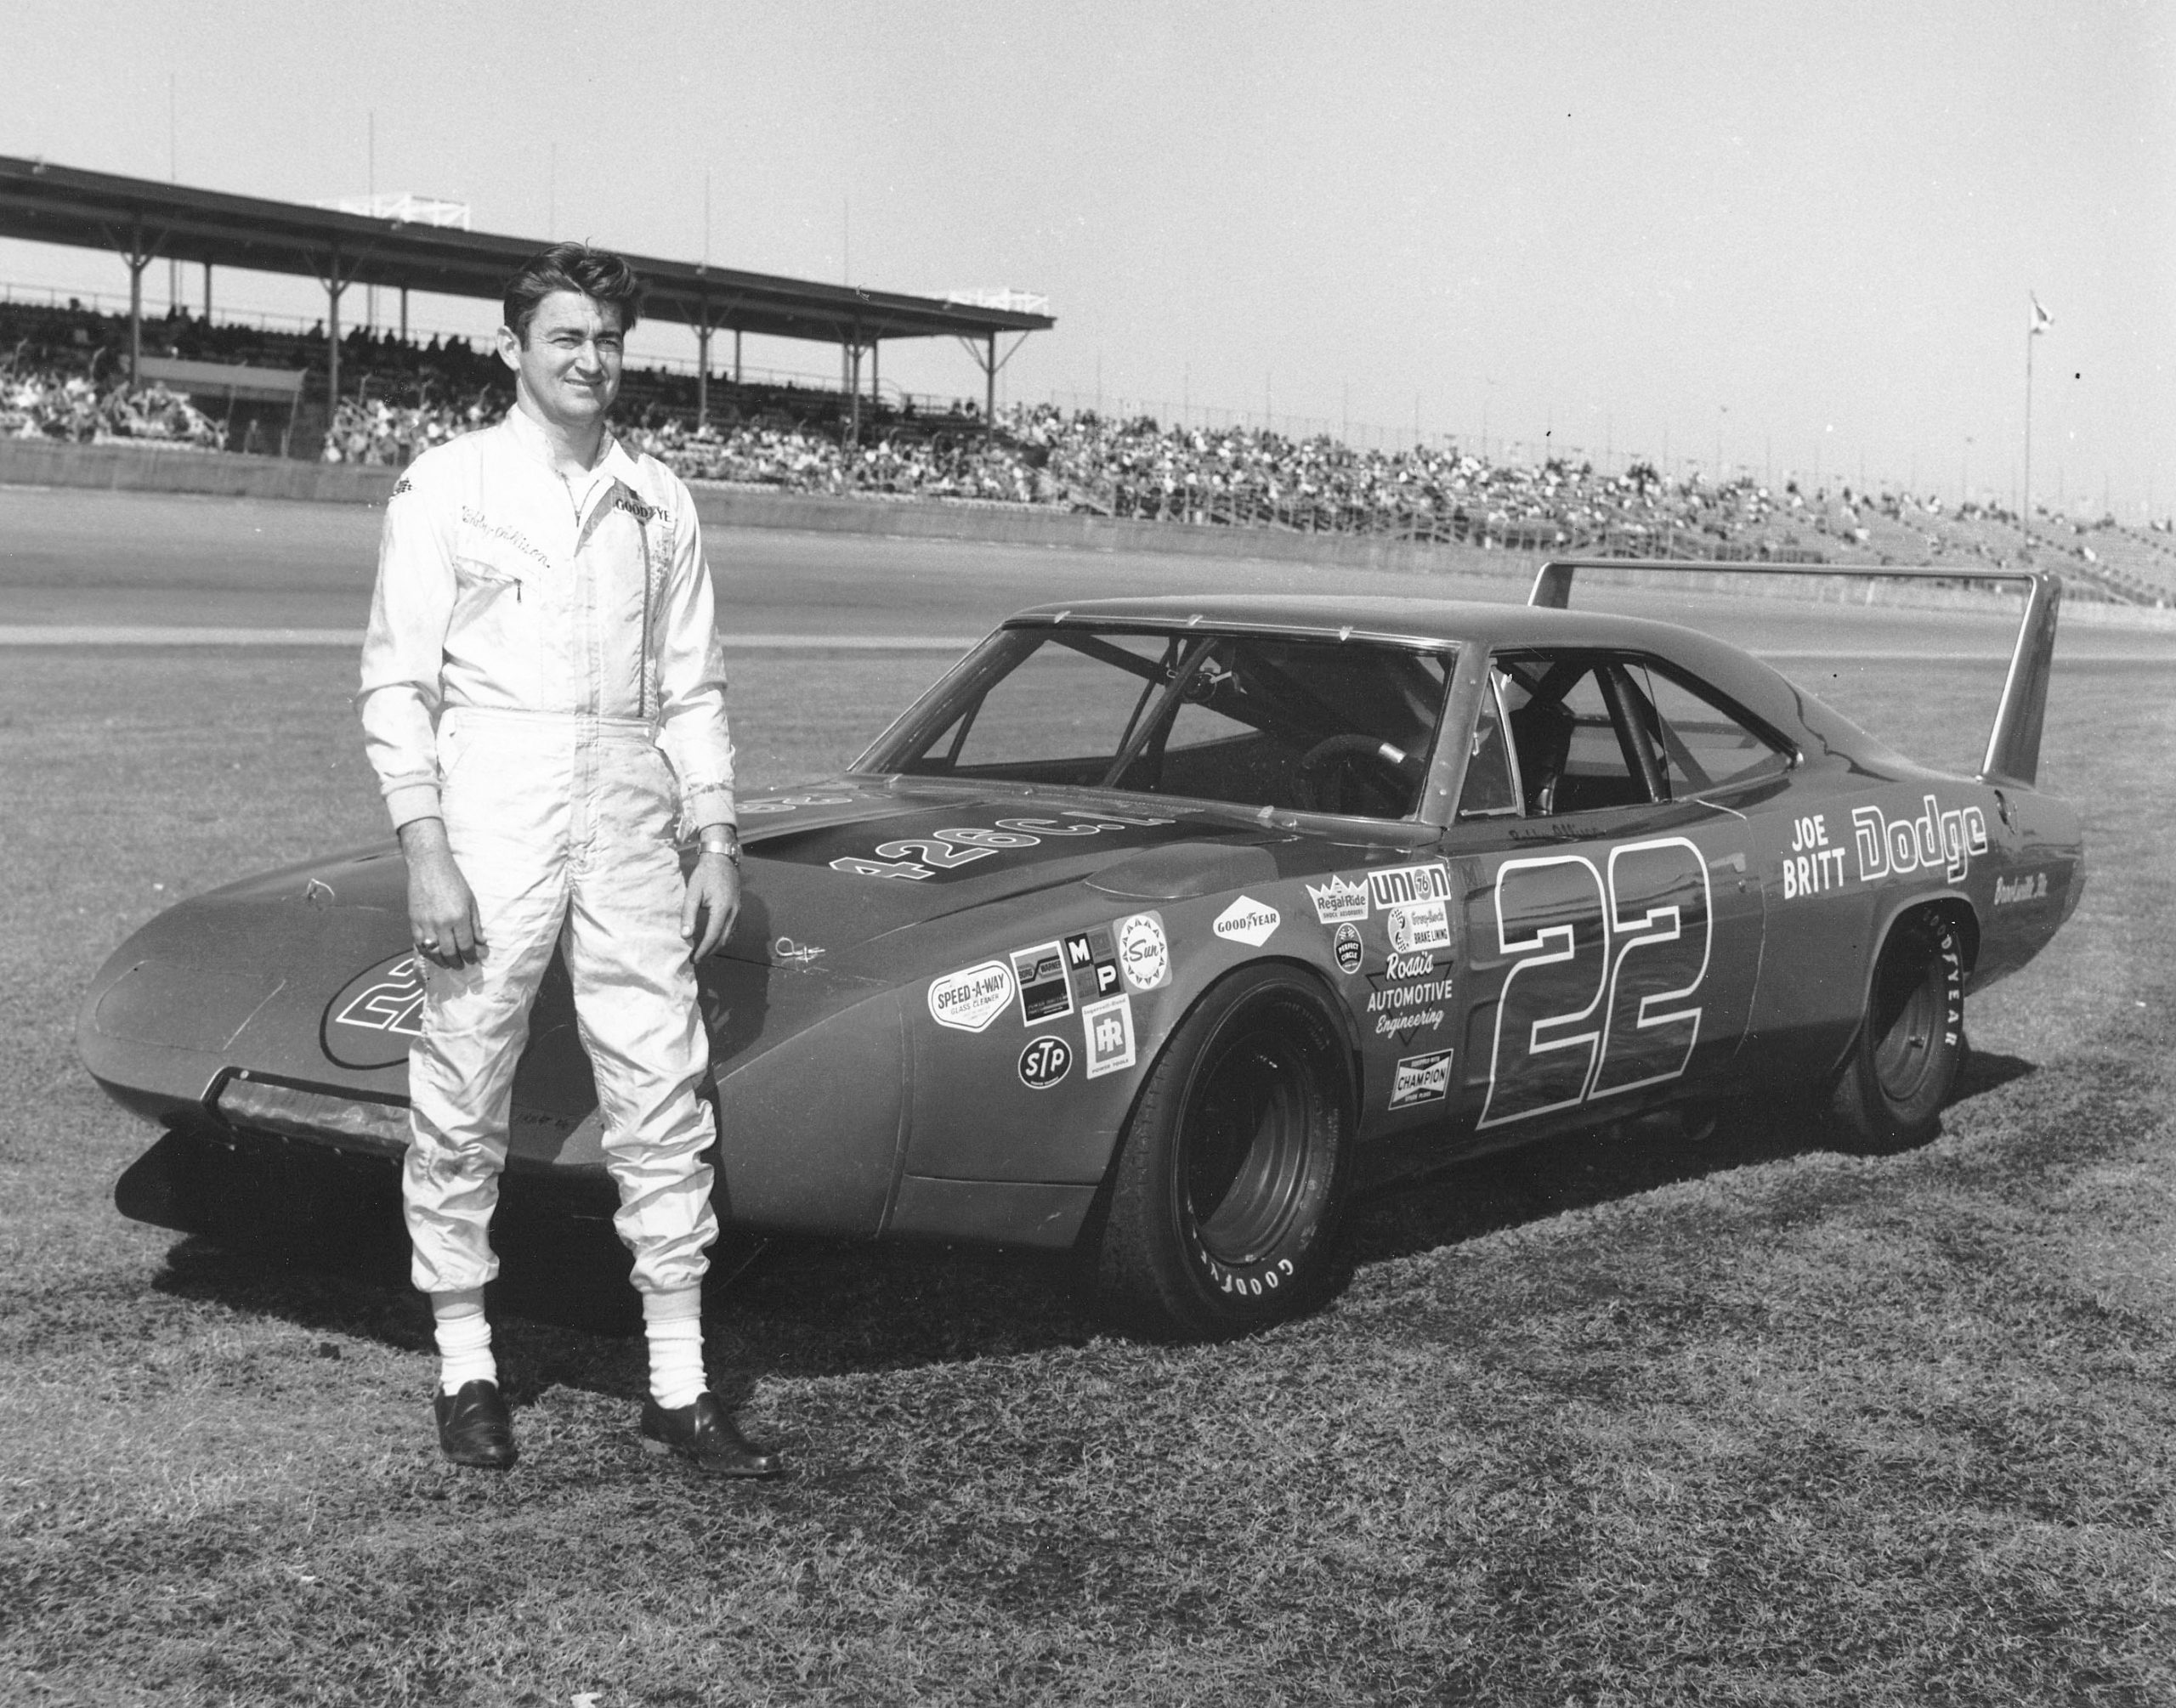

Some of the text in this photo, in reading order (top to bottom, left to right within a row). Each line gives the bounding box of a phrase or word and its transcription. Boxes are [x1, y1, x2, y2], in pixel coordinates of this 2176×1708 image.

[1792, 814, 1829, 851] JOE
[1851, 794, 1988, 884] Dodge
[830, 828, 1041, 880] 426
[1416, 874, 1430, 893] 76
[1783, 847, 1846, 900] BRITT
[1068, 938, 1091, 964] M
[1129, 938, 1159, 962] Sun
[1338, 942, 1359, 954] PERFECT
[1341, 952, 1357, 961] CIRCLE
[1096, 965, 1117, 992] P
[1476, 836, 1713, 1131] 22
[950, 1003, 971, 1015] GLASS
[972, 993, 1000, 1008] CLEANER
[1367, 979, 1453, 1013] AUTOMOTIVE
[1375, 1010, 1445, 1038] Engineering
[1025, 1041, 1065, 1078] STP
[1397, 1067, 1446, 1091] CHAMPION
